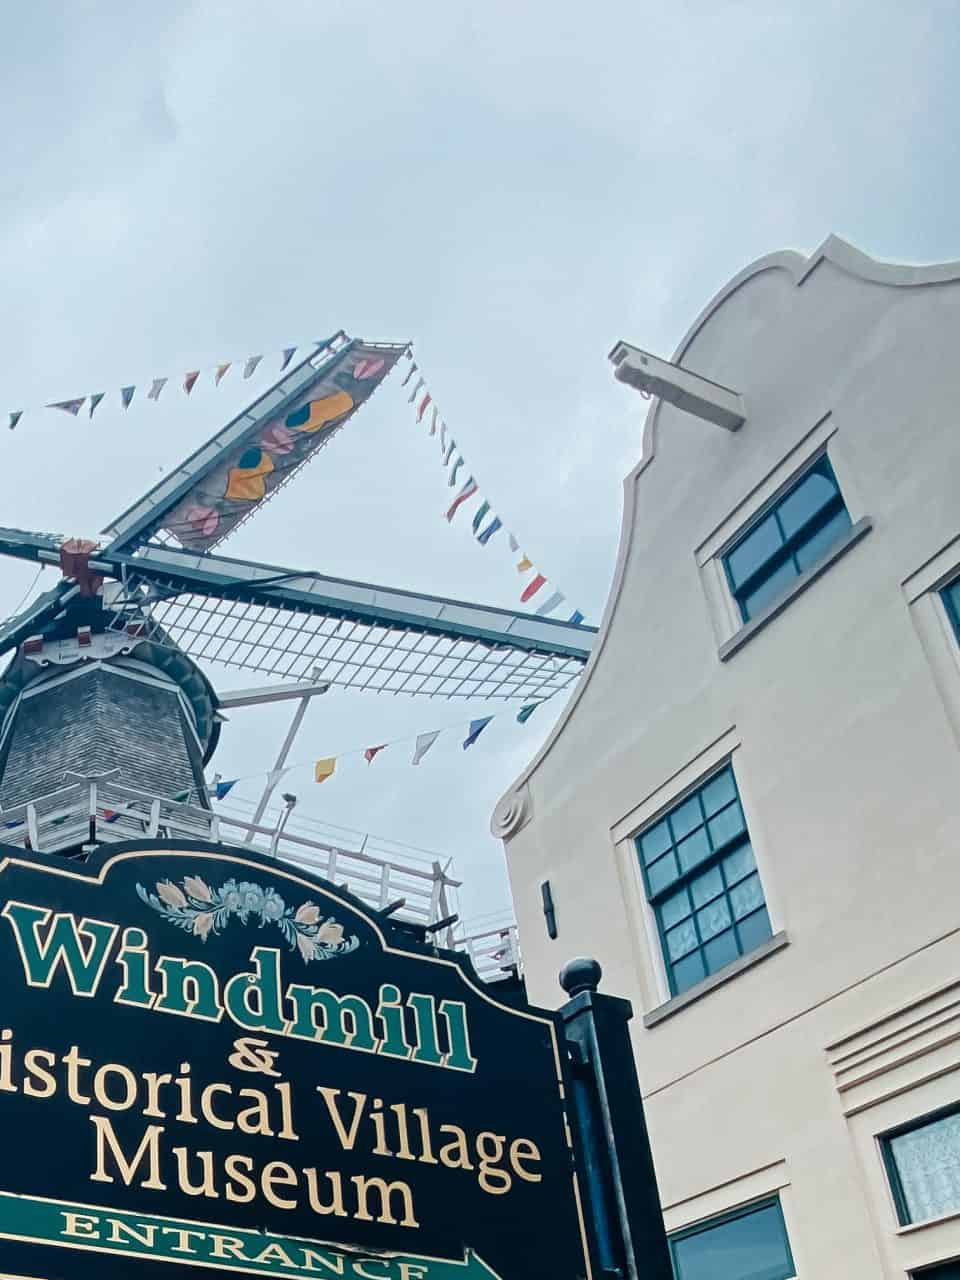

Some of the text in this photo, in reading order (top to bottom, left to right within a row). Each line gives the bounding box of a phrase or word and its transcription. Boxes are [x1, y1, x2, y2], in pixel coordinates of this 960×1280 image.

[1, 901, 478, 1074] Windmill
[228, 1037, 282, 1077] &
[89, 1115, 420, 1228] Museum
[316, 1086, 542, 1195] Village
